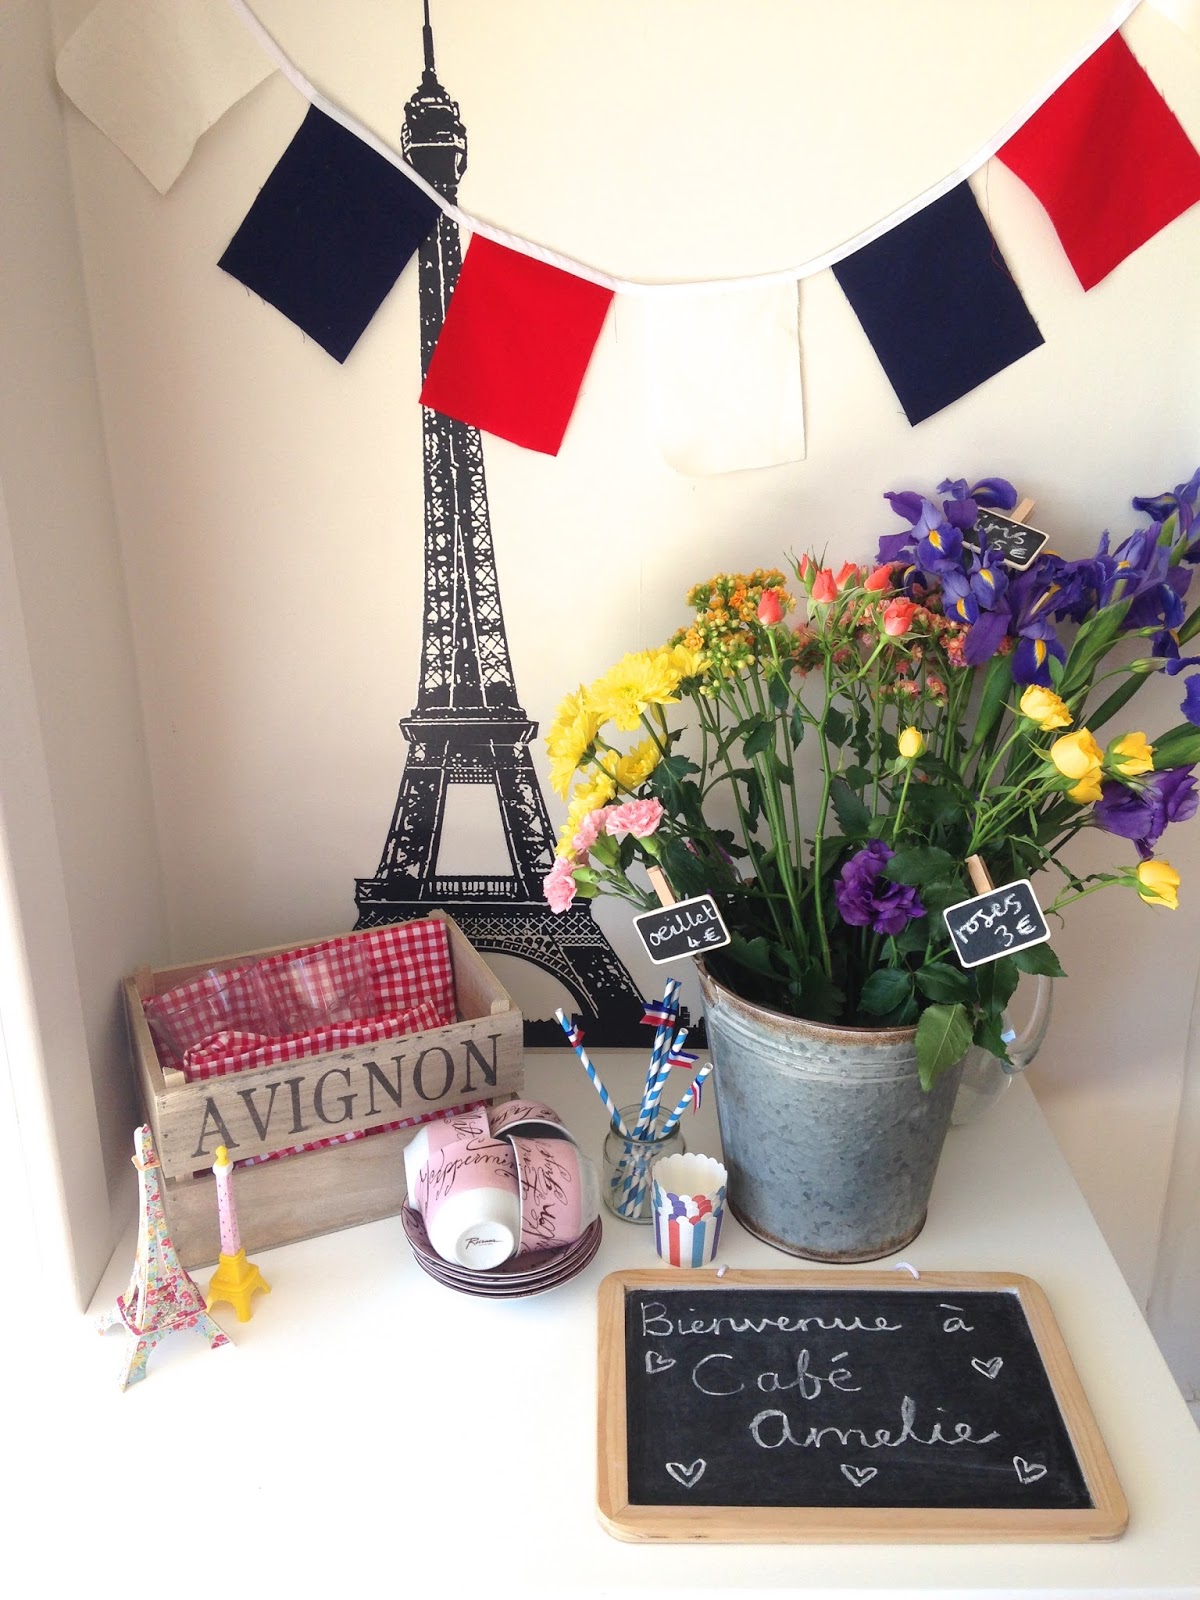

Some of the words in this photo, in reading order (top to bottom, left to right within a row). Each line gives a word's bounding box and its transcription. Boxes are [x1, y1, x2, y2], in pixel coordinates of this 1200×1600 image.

[955, 893, 1022, 945] roses
[190, 1033, 503, 1158] AVIGNON
[640, 1302, 902, 1337] Bienvenue
[937, 1303, 974, 1333] à
[691, 1349, 863, 1400] Café
[748, 1396, 1002, 1448] Amelie
